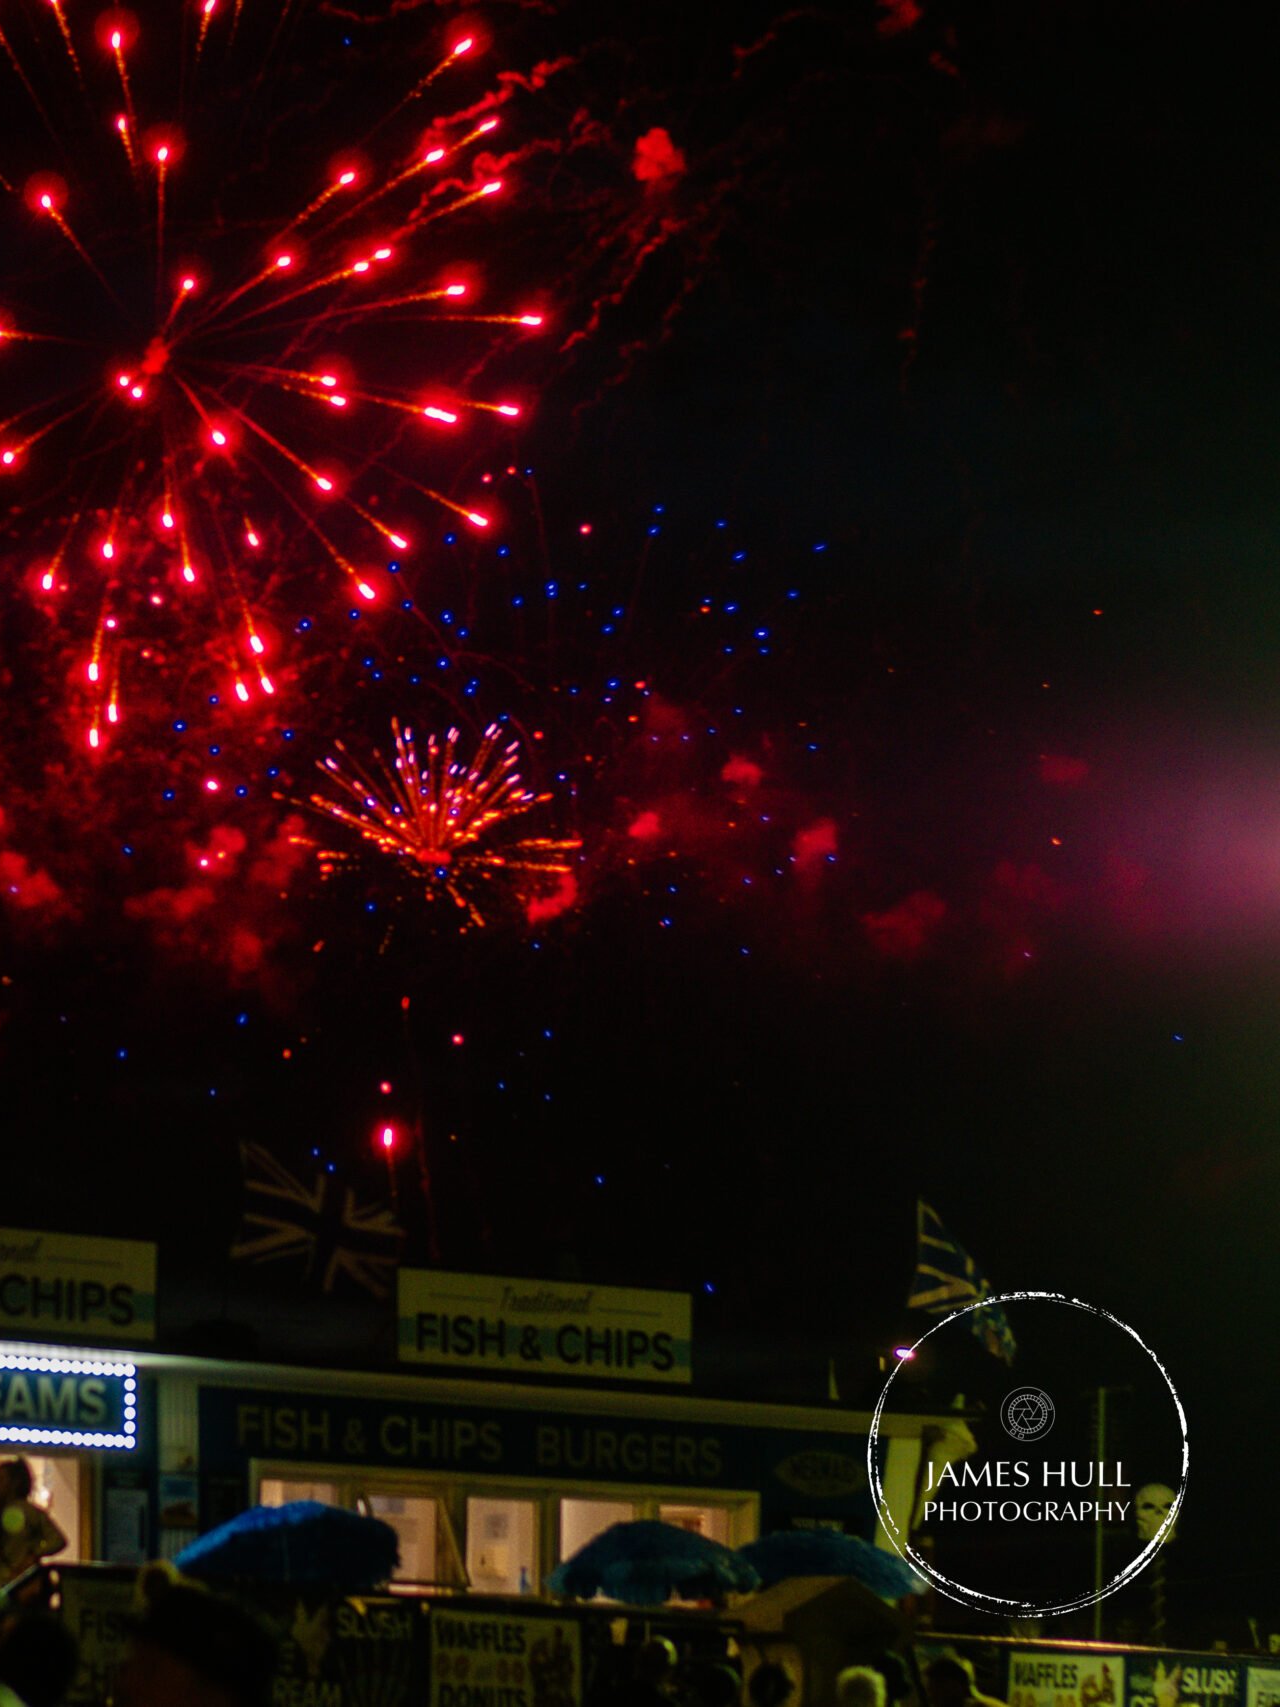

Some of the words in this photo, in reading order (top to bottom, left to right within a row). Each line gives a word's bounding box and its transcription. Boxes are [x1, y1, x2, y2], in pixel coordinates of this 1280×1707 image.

[0, 1274, 135, 1326] CHIPS
[499, 1286, 594, 1314] Traditional
[416, 1313, 506, 1358] FISH
[520, 1325, 542, 1361] &
[557, 1325, 674, 1371] CHIPS
[236, 1404, 331, 1451] FISH
[342, 1416, 369, 1456] &
[379, 1414, 504, 1463] CHIPS
[535, 1424, 723, 1476] BURGERS
[335, 1605, 414, 1641] SLUSH
[436, 1616, 527, 1654] WAFFLES
[271, 1675, 344, 1707] REAM
[1014, 1662, 1079, 1690] WAFFLES
[439, 1682, 527, 1707] DONUTS
